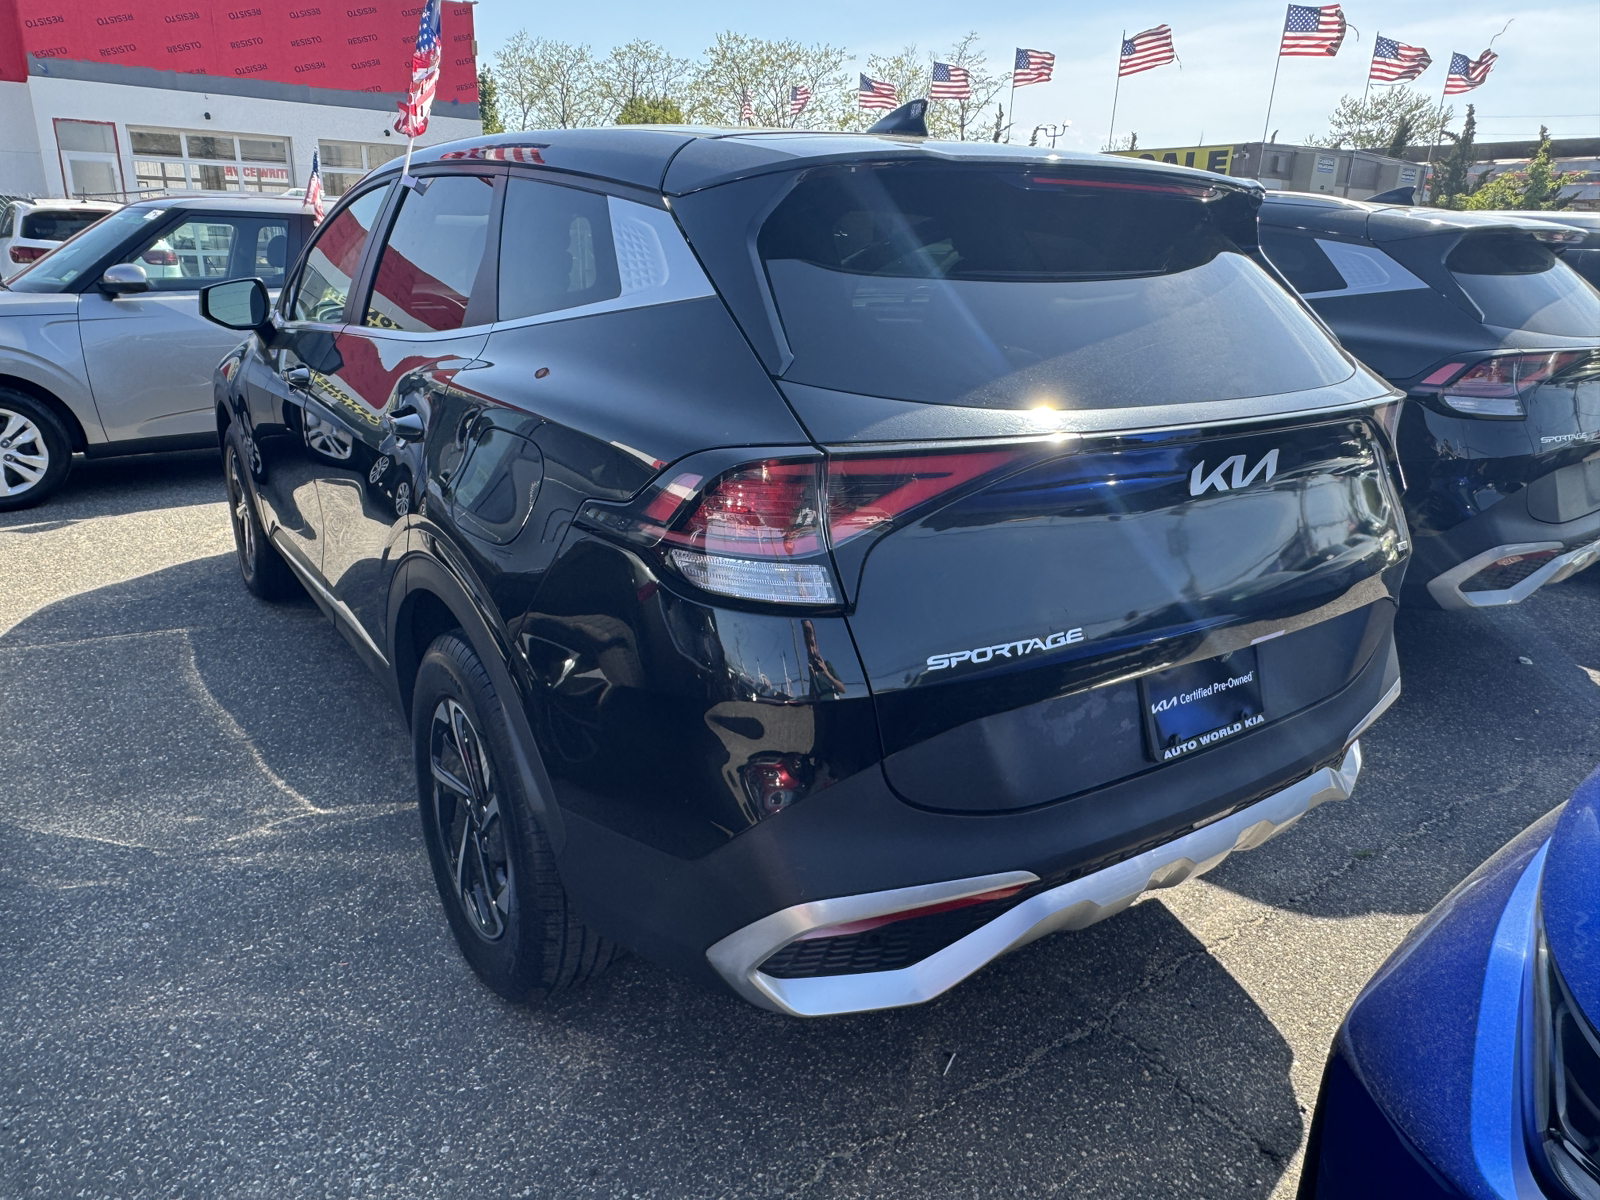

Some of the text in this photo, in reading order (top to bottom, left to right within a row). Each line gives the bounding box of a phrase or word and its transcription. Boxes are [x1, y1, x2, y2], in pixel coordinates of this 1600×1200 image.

[164, 11, 200, 24] RESISTO
[228, 8, 262, 20] RESISTO
[289, 8, 321, 19] RESISTO
[346, 7, 377, 17] RESISTO
[25, 15, 64, 28] RESISTO
[97, 13, 134, 26] RESISTO
[230, 37, 263, 49] RESISTO
[290, 35, 322, 47] RESISTO
[347, 34, 378, 45] RESISTO
[31, 47, 68, 58] ESISTO
[99, 44, 137, 57] RESISTO
[166, 41, 201, 53] RESISTO
[234, 63, 268, 75] RESISTO
[294, 61, 326, 73] RESISTO
[351, 58, 381, 70] RESISTO
[456, 82, 478, 92] RESIST
[1540, 432, 1588, 444] SPORTAGE
[1189, 448, 1280, 496] KIA
[926, 627, 1084, 671] SPORTAGE
[1151, 696, 1178, 714] KIA
[1180, 685, 1213, 705] Certified
[1164, 714, 1265, 760] AUTO WORLD KIA
